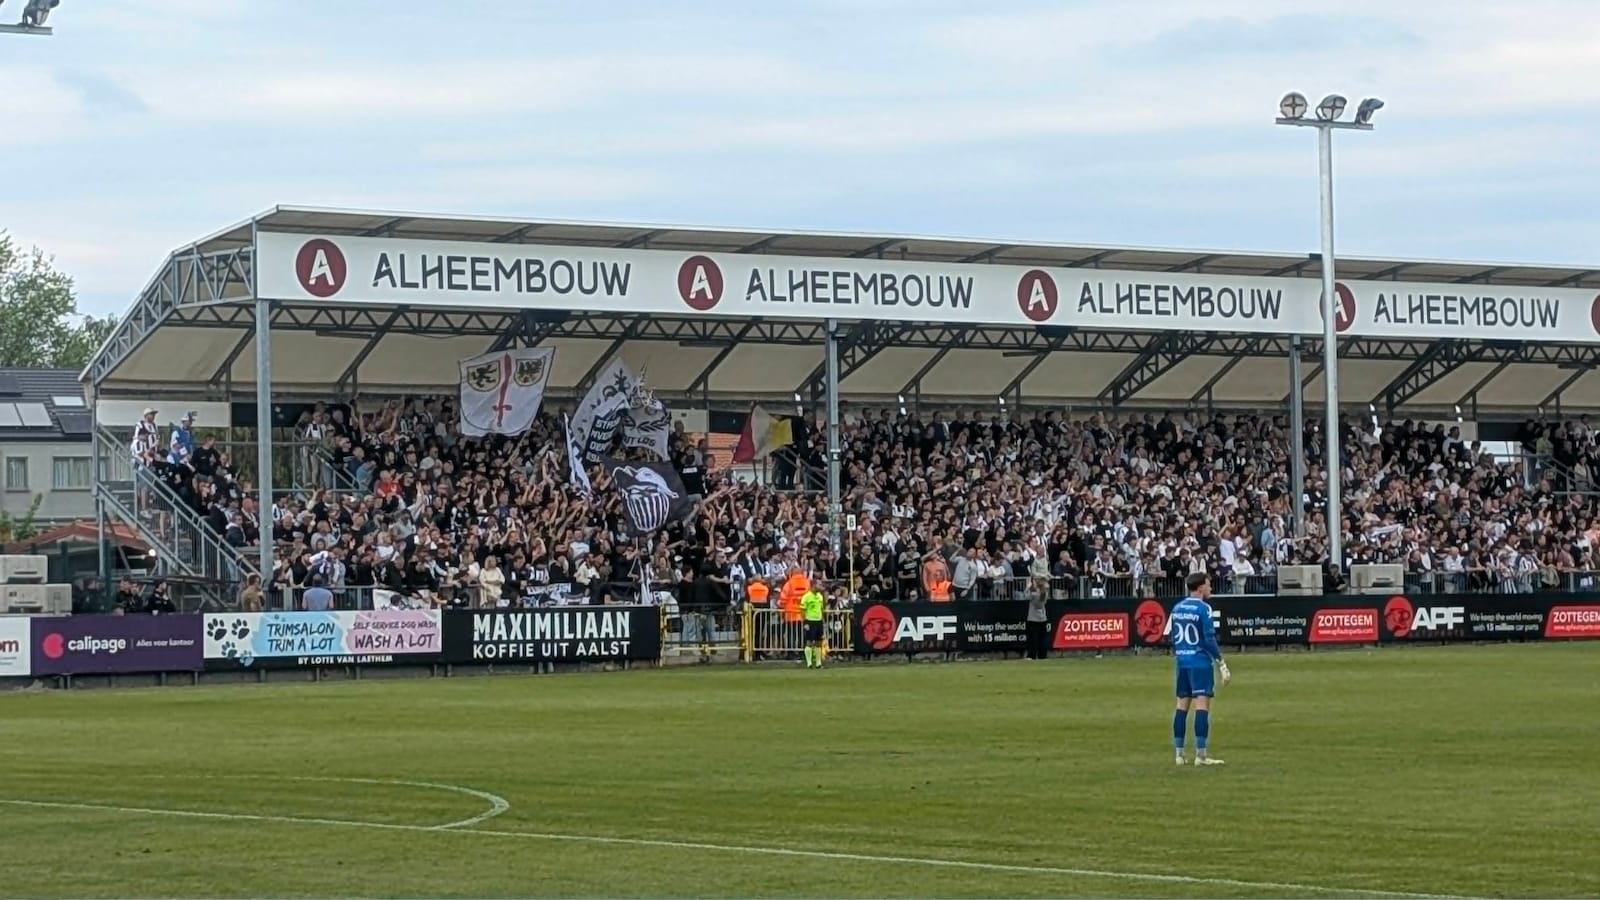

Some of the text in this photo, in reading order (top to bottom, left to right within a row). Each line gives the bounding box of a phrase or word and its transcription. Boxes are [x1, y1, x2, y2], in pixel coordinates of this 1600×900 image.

[373, 252, 630, 296] ALHEEMBOUW
[746, 268, 973, 309] ALHEEMBOUW
[1078, 282, 1282, 320] ALHEEMBOUW
[1373, 293, 1559, 328] ALHEEMBOUW
[352, 620, 438, 630] SELF SERVICE DOG WASH
[1227, 616, 1306, 628] We keep the world moving
[1318, 614, 1373, 627] ZOTTEGEM
[1410, 606, 1465, 631] APF
[1470, 612, 1543, 623] We keep the world moving
[266, 622, 336, 638] TRIMSALON
[473, 611, 631, 642] MAXIMILIAAN
[893, 615, 958, 642] APF
[964, 622, 1026, 633] We keep the world
[1064, 619, 1124, 633] ZOTTEGEM
[1230, 628, 1244, 637] with
[1244, 628, 1253, 636] 15
[1254, 628, 1276, 636] million
[1287, 628, 1302, 636] parts
[1473, 624, 1539, 632] with 15 million car parts
[68, 635, 126, 654] calipage
[169, 638, 194, 646] kantoor
[268, 637, 336, 653] TRIM A LOT
[354, 633, 436, 649] WASH A LOT
[968, 634, 982, 643] with
[984, 634, 993, 643] 15
[994, 634, 1018, 642] million
[473, 641, 631, 659] KOFFIE UIT AALST
[298, 655, 393, 665] BY LOTTE VAN LAETHEM
